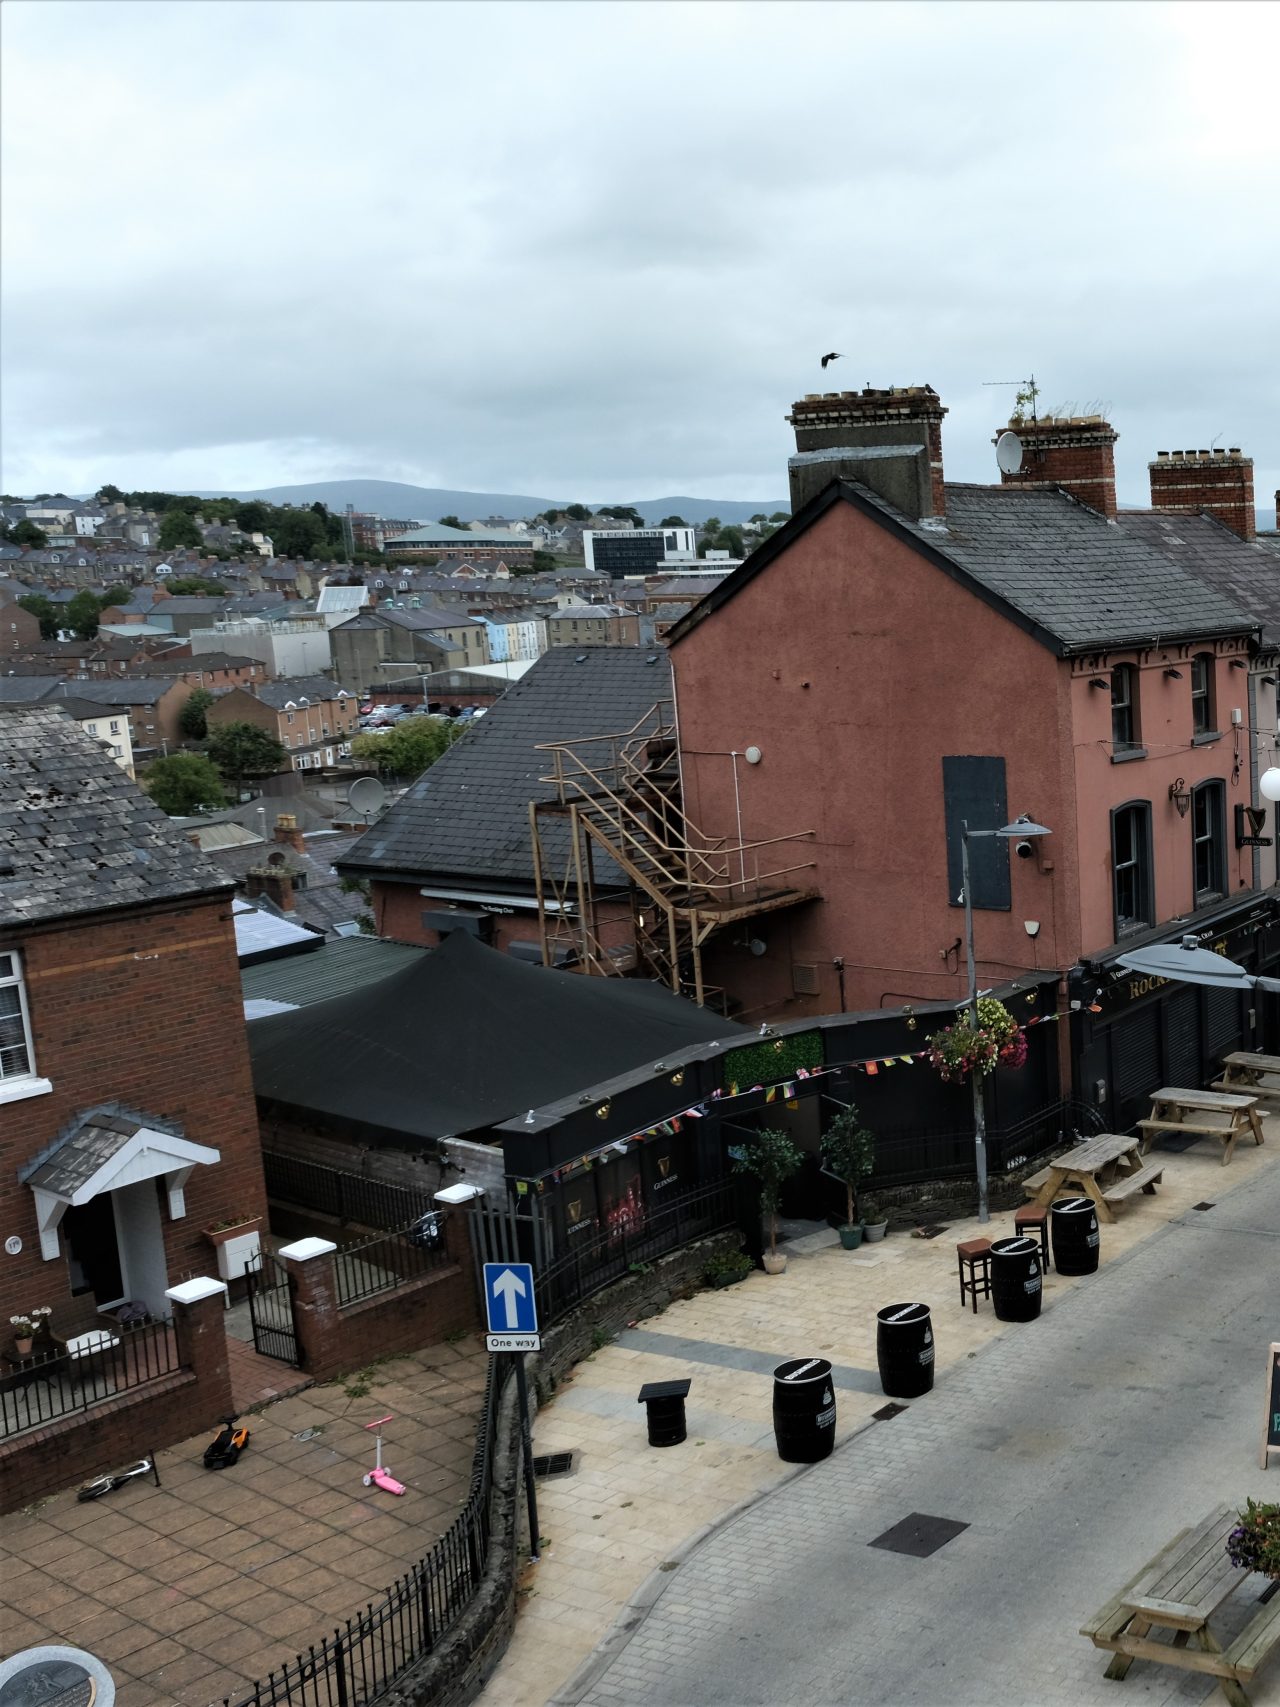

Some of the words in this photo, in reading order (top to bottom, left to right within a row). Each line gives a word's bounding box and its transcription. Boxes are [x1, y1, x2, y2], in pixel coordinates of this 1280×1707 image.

[653, 1174, 678, 1191] GUINNESS
[491, 1338, 512, 1347] One
[515, 1339, 536, 1348] way
